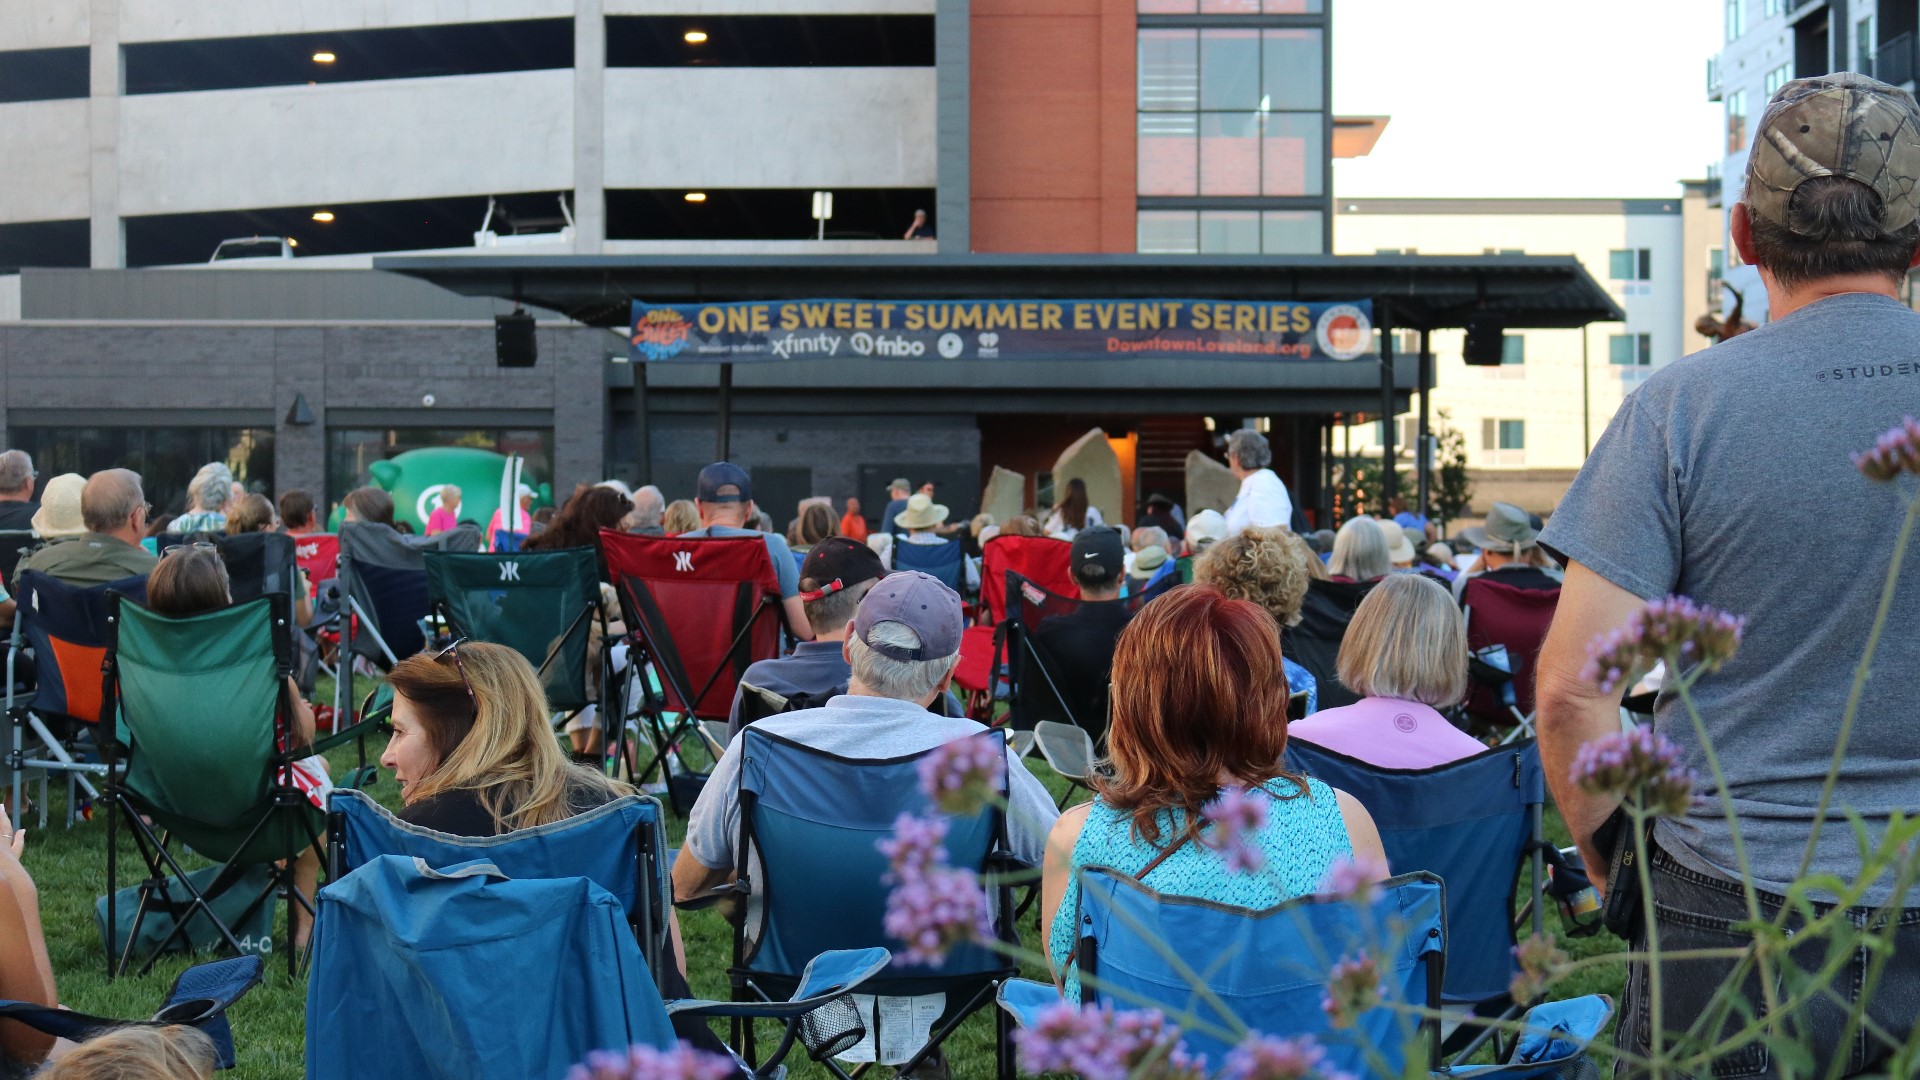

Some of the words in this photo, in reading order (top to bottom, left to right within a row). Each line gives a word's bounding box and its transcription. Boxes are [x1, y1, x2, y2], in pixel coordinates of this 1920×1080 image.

[699, 306, 770, 333] ONE
[780, 303, 896, 330] SWEET
[905, 303, 1062, 330] SUMMER
[1074, 303, 1183, 330] EVENT
[1191, 303, 1311, 333] SERIES
[772, 332, 841, 359] xfinity
[876, 335, 925, 356] fnbo
[1106, 336, 1311, 359] DowntownLoveland.org
